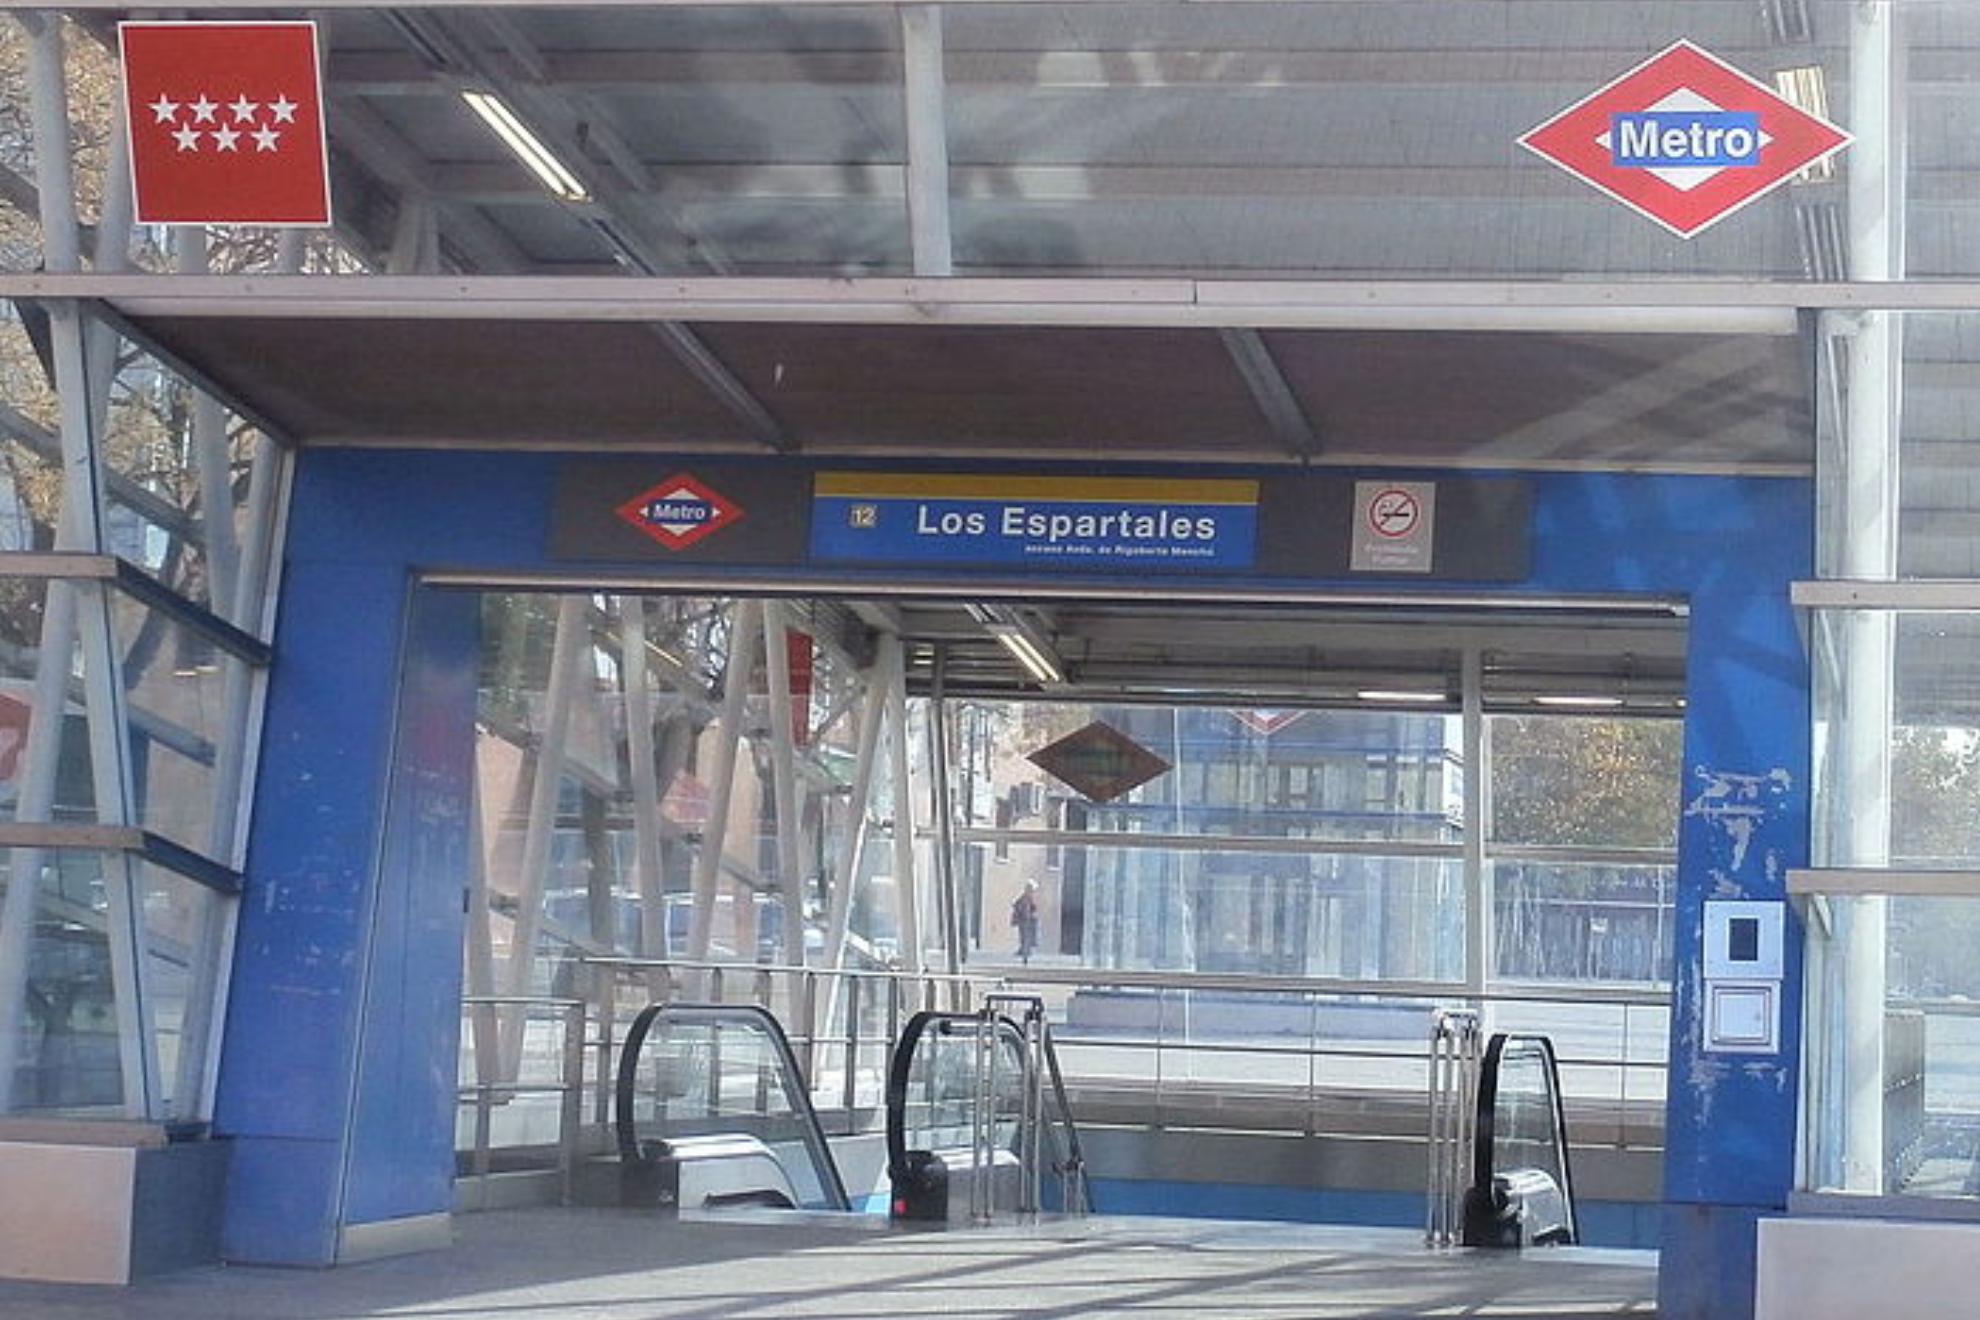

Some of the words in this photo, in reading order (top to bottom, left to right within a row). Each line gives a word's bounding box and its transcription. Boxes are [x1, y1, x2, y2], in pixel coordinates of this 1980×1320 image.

[1619, 119, 1752, 159] Metro
[652, 503, 706, 520] Metro
[851, 507, 876, 526] 12
[917, 504, 987, 535] Los
[1002, 506, 1216, 543] Espartales
